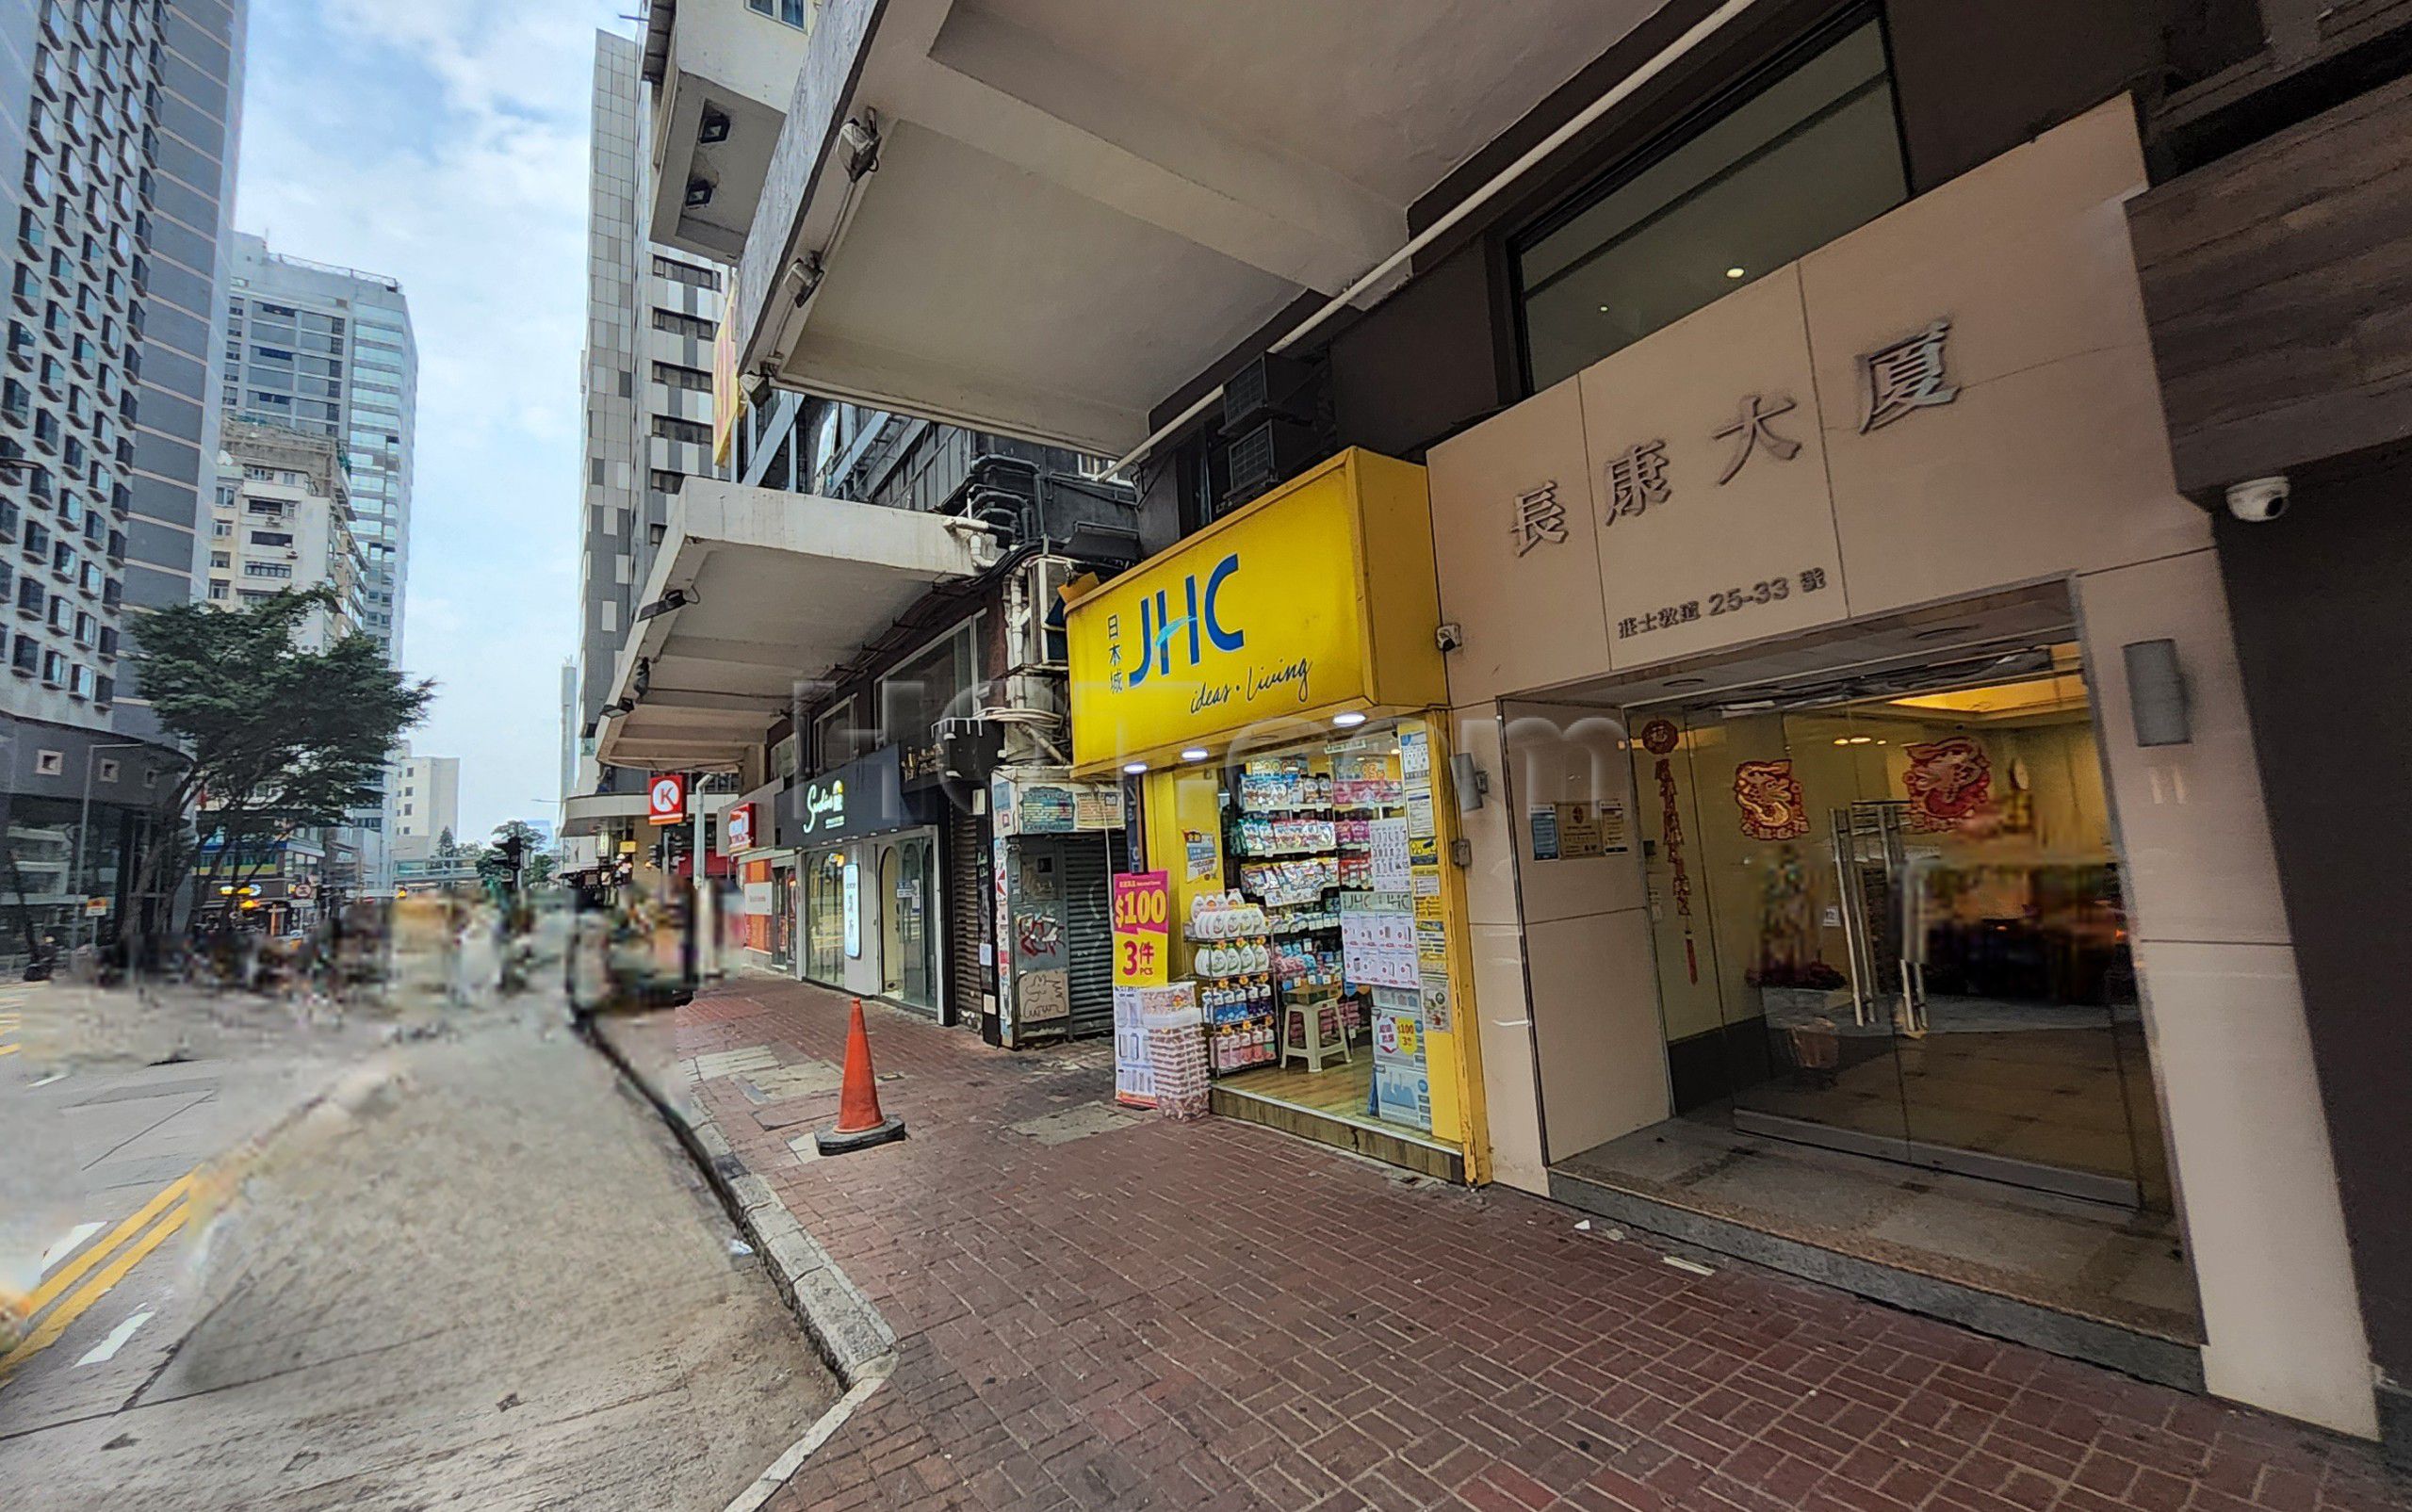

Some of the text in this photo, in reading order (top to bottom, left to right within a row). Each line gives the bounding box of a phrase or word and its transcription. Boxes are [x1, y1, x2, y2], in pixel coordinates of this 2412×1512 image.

[1709, 577, 1789, 616] 25-33
[1128, 552, 1245, 689] JHC
[1190, 682, 1230, 714] ideas
[1115, 888, 1166, 929] $100
[1123, 940, 1154, 977] 3件
[1140, 967, 1154, 976] PCS
